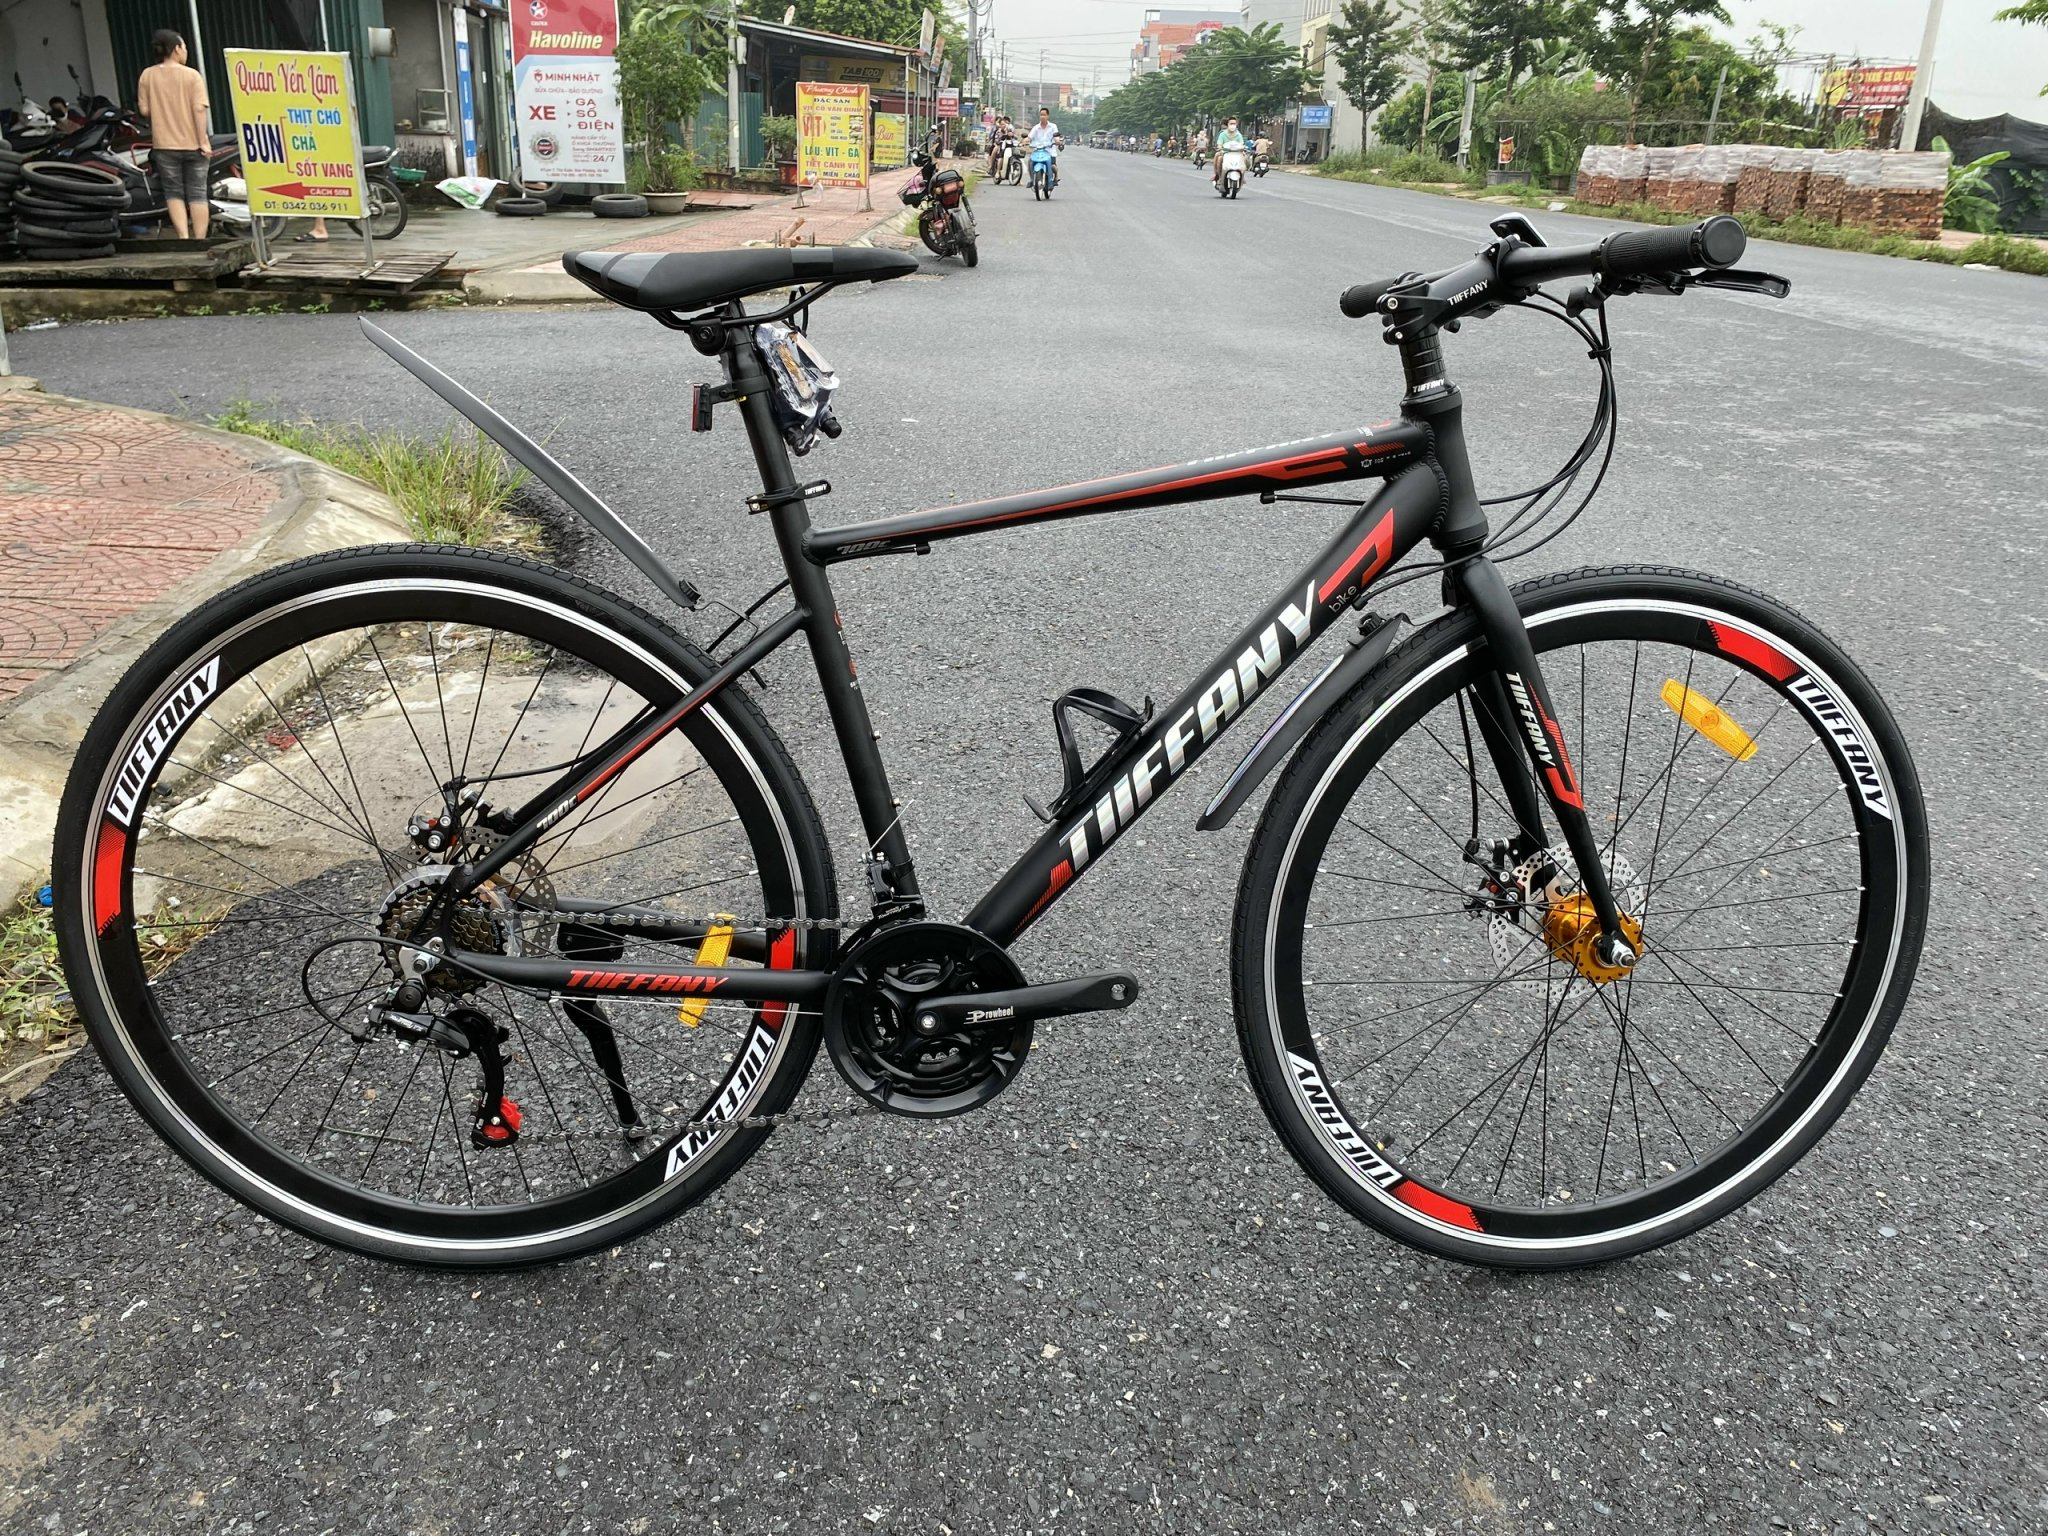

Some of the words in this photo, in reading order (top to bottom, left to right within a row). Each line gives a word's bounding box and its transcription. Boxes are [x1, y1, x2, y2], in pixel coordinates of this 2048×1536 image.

[529, 30, 604, 50] Havoline
[235, 60, 277, 96] Quán
[545, 73, 572, 81] MINH
[529, 105, 556, 120] XE
[576, 98, 596, 106] GA
[287, 108, 313, 128] THỊT
[316, 107, 341, 125] CHÓ
[576, 108, 597, 118] SỐ
[577, 120, 614, 132] ĐIỆN
[242, 115, 285, 164] BÚN
[292, 131, 317, 151] CHẢ
[296, 156, 318, 177] SỐT
[321, 163, 354, 178] VANG
[592, 154, 615, 162] 24/7
[282, 202, 307, 210] 0342
[310, 202, 328, 210] 036
[330, 202, 348, 212] 911
[1447, 279, 1489, 306] TIIFFANY
[1328, 585, 1357, 613] bike
[1058, 579, 1315, 872] TIIFFANY
[1505, 671, 1556, 767] TIIFFANY
[109, 661, 214, 820] TIIFFANY
[1794, 673, 1889, 811] TIIFFANY
[566, 969, 729, 993] TIIFFANY
[965, 1005, 1014, 1023] Prowheel
[1291, 1060, 1394, 1187] TIIFFANY
